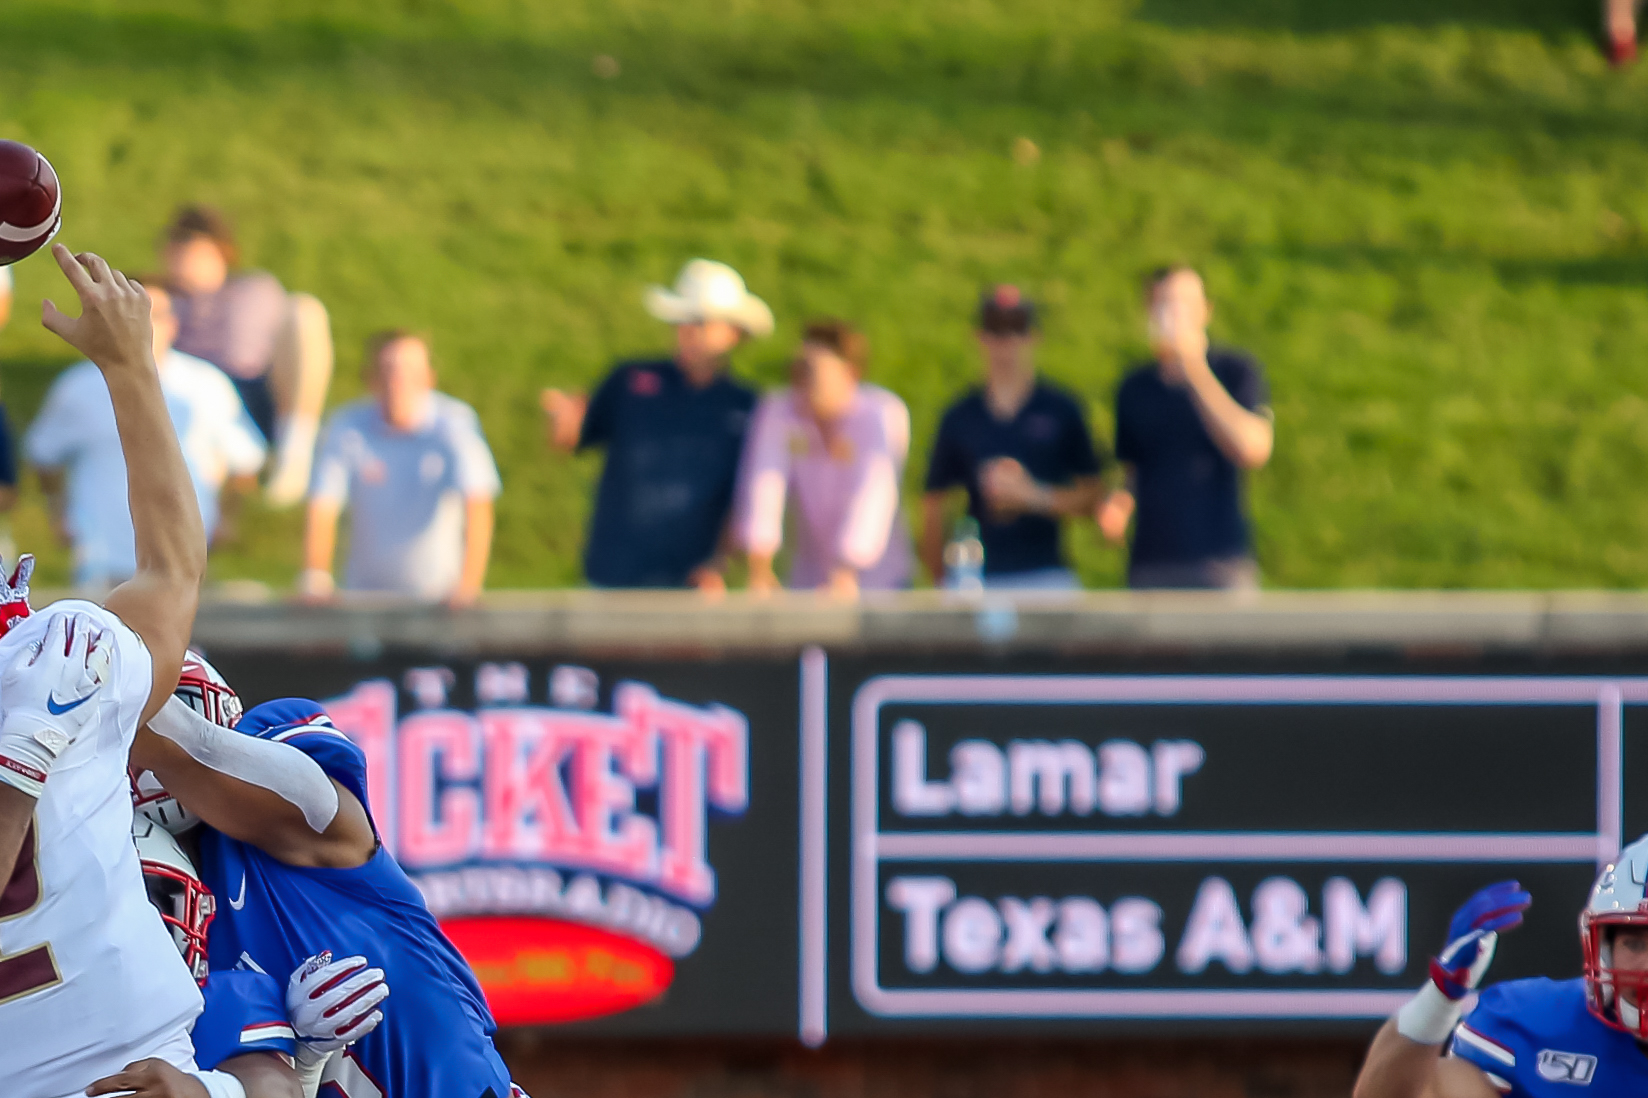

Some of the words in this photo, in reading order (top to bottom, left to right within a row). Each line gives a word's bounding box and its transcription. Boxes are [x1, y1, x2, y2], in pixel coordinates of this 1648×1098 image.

[324, 678, 749, 908] ICKET
[891, 719, 1206, 816] Lamar
[885, 875, 1164, 974] Texas
[1176, 875, 1408, 974] A&M
